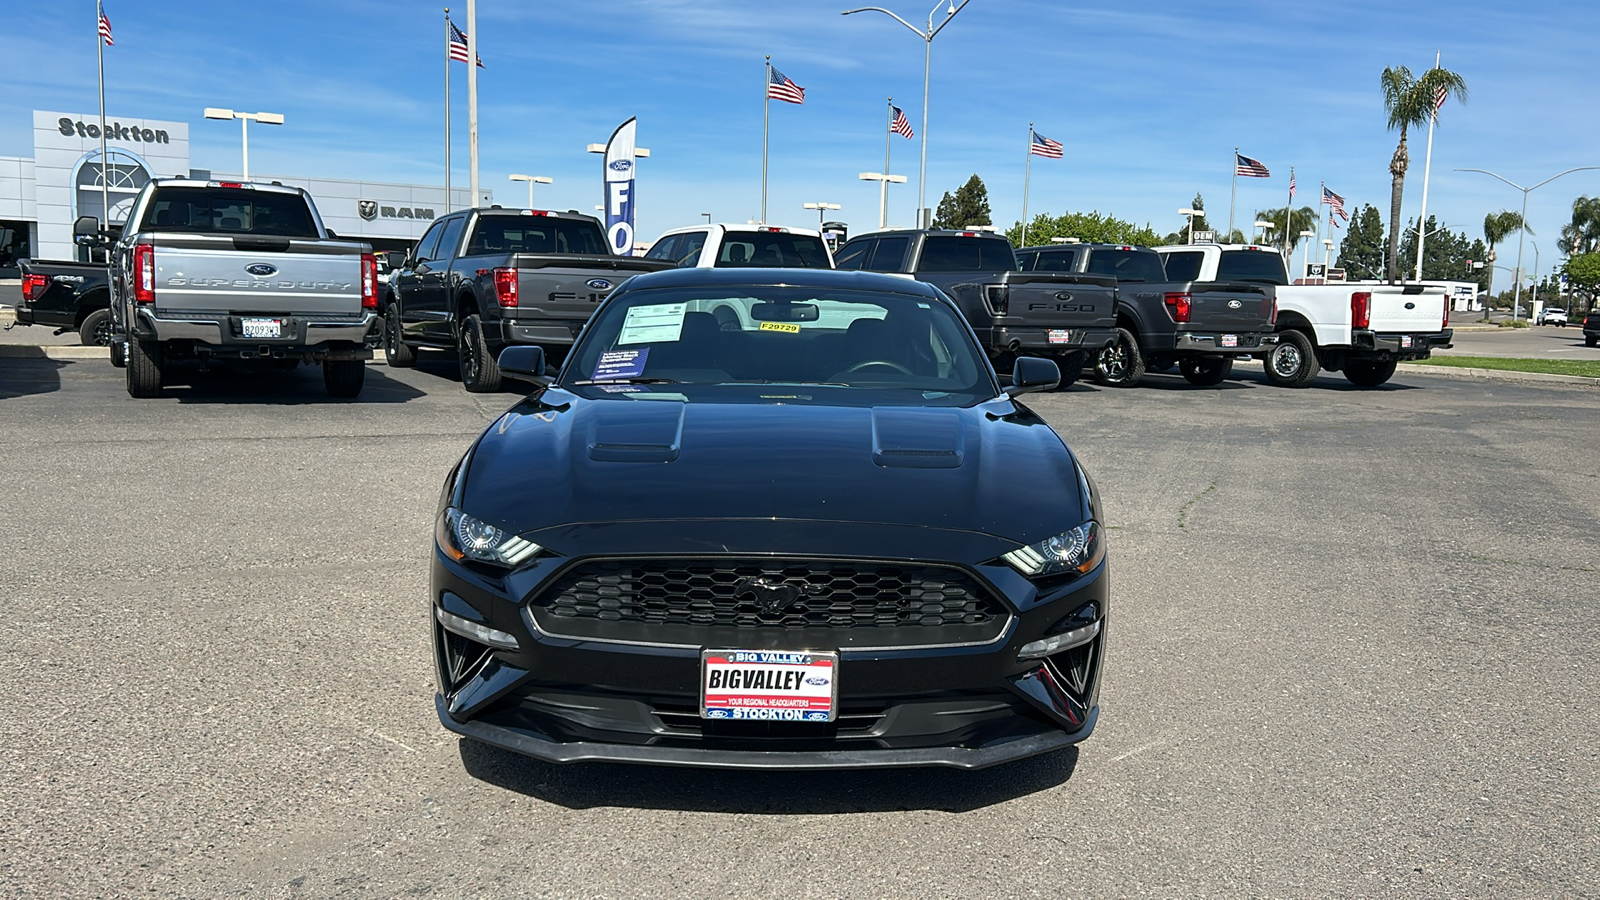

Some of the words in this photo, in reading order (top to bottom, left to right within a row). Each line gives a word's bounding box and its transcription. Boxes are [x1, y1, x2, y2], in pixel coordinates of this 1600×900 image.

[58, 117, 169, 144] Stockton
[381, 206, 435, 220] RAM
[1194, 232, 1213, 240] OEM
[168, 277, 270, 289] SUPER
[278, 280, 351, 290] DUTY
[1028, 303, 1096, 312] F-150
[761, 323, 797, 331] F29729
[736, 653, 757, 661] BIG
[761, 654, 805, 664] VALLEY
[708, 669, 806, 690] BIGVALLEY
[728, 698, 742, 706] YOUR
[743, 698, 768, 706] REGIONAL
[769, 699, 809, 707] HEADQUARTERS
[732, 709, 804, 720] STOCKTON
